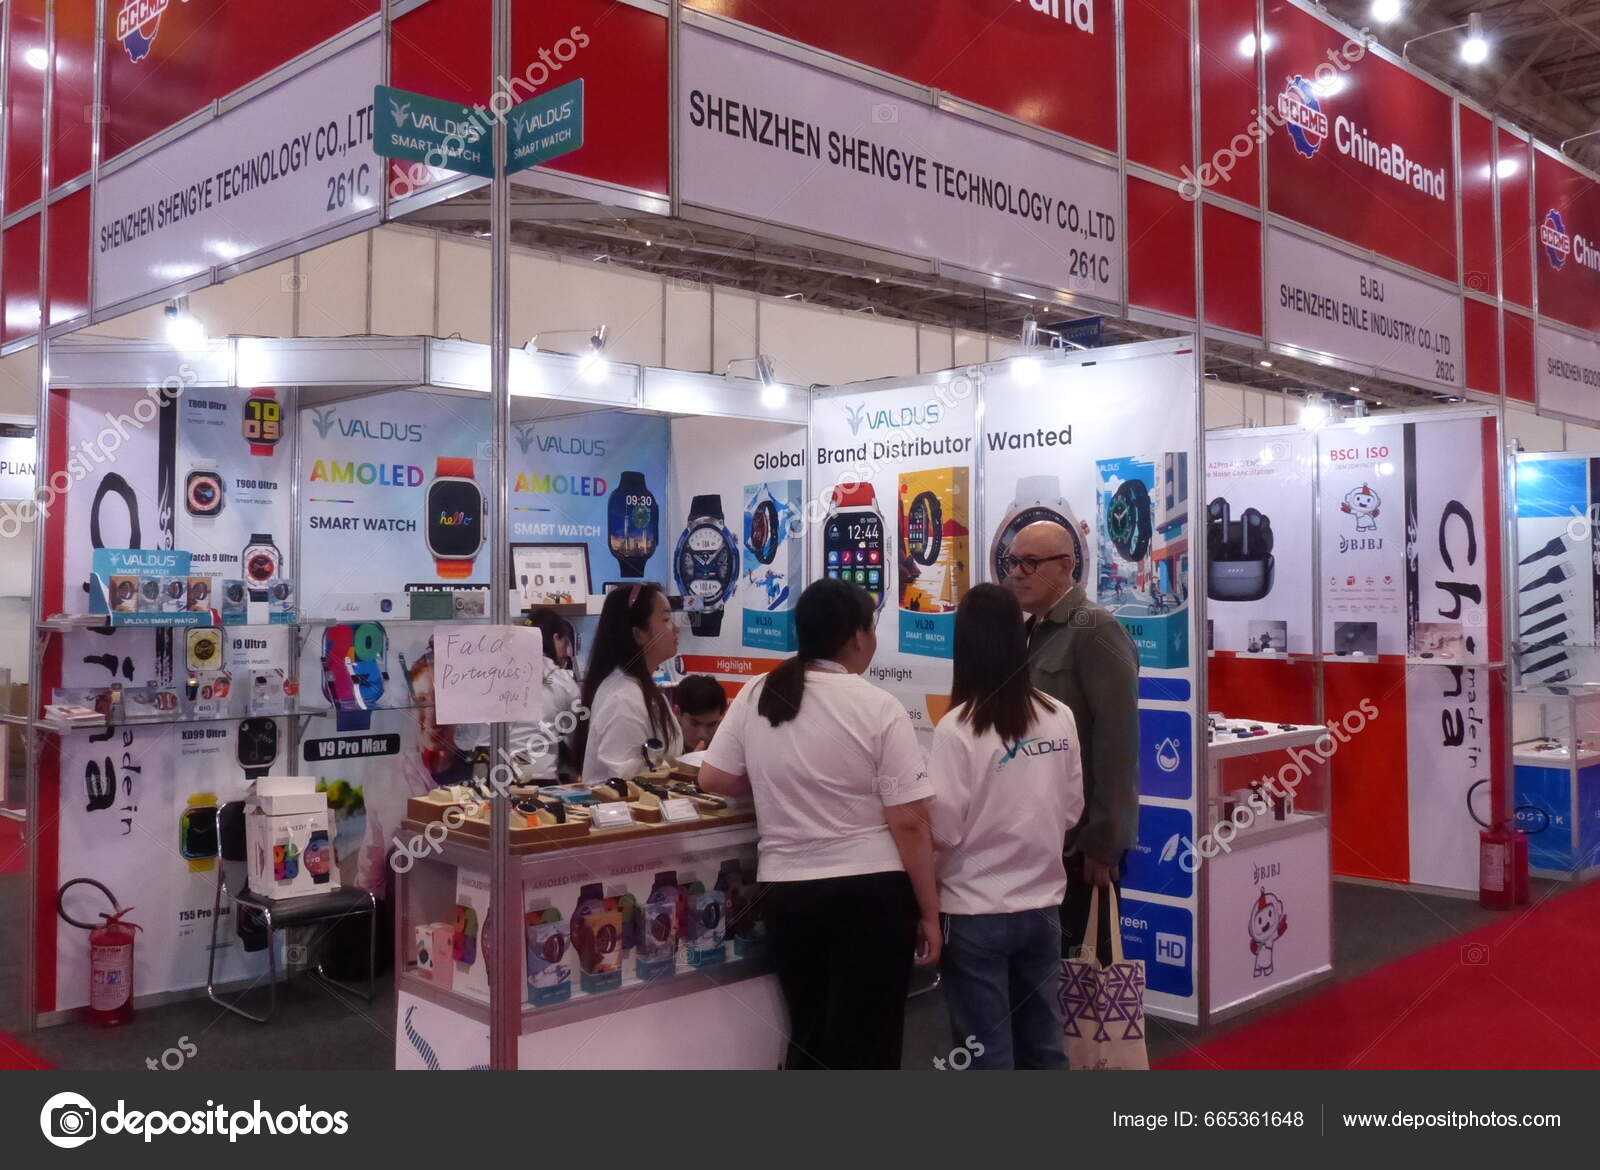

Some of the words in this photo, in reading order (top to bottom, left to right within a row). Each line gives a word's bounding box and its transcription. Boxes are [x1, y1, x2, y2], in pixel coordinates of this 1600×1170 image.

[411, 110, 481, 143] VALDUS
[525, 102, 572, 133] VALDUS
[391, 133, 433, 154] SMART
[435, 142, 481, 163] WATCH
[513, 141, 540, 160] SMART
[541, 129, 572, 150] WATCH
[689, 90, 821, 159] SHENZHEN
[827, 130, 927, 189] SHENGYE
[932, 161, 1053, 225] TECHNOLOGY
[1056, 200, 1116, 243] CO.,LTD
[1335, 115, 1446, 201] ChinaBrand
[100, 206, 155, 252] SHENZHEN
[157, 178, 213, 229] SHENGYE
[216, 131, 312, 203] TECHNOLOGY
[326, 163, 370, 212] 261C
[1069, 248, 1110, 284] 261C
[1360, 275, 1385, 303] BJBJ
[1280, 283, 1339, 322] SHENZHEN
[1342, 303, 1369, 331] ENLE
[1371, 312, 1417, 345] INDUSTRY
[1435, 360, 1455, 382] 262C
[867, 404, 939, 430] VALDUS
[338, 417, 424, 442] VALDUS
[537, 436, 607, 457] VALDUS
[753, 449, 805, 471] Global
[817, 442, 867, 465] Brand
[873, 435, 972, 460] Distributor
[987, 424, 1072, 451] Wanted
[1330, 448, 1359, 461] BSCI
[1366, 446, 1389, 459] ISO
[309, 459, 425, 487] AMOLED
[236, 479, 257, 489] T900
[258, 480, 278, 490] Ultra
[513, 472, 608, 497] AMOLED
[626, 495, 652, 506] 09:30
[309, 515, 359, 531] SMART
[364, 518, 417, 533] WATCH
[439, 511, 473, 527] hello
[513, 522, 556, 536] SMART
[557, 524, 601, 538] WATCH
[848, 524, 879, 540] 12:44
[122, 554, 176, 567] VALDUS
[191, 553, 211, 562] atch
[233, 638, 243, 650] i9
[244, 639, 267, 649] Ultra
[716, 659, 753, 673] Highlight
[869, 667, 913, 682] Highlight
[907, 710, 923, 720] sis
[182, 729, 205, 740] KD99
[206, 728, 227, 739] Ultra
[319, 741, 337, 757] V9
[338, 740, 359, 756] Pro
[361, 738, 387, 754] Max
[179, 910, 196, 921] T55
[196, 909, 212, 919] Pro
[1157, 939, 1184, 960] HD
